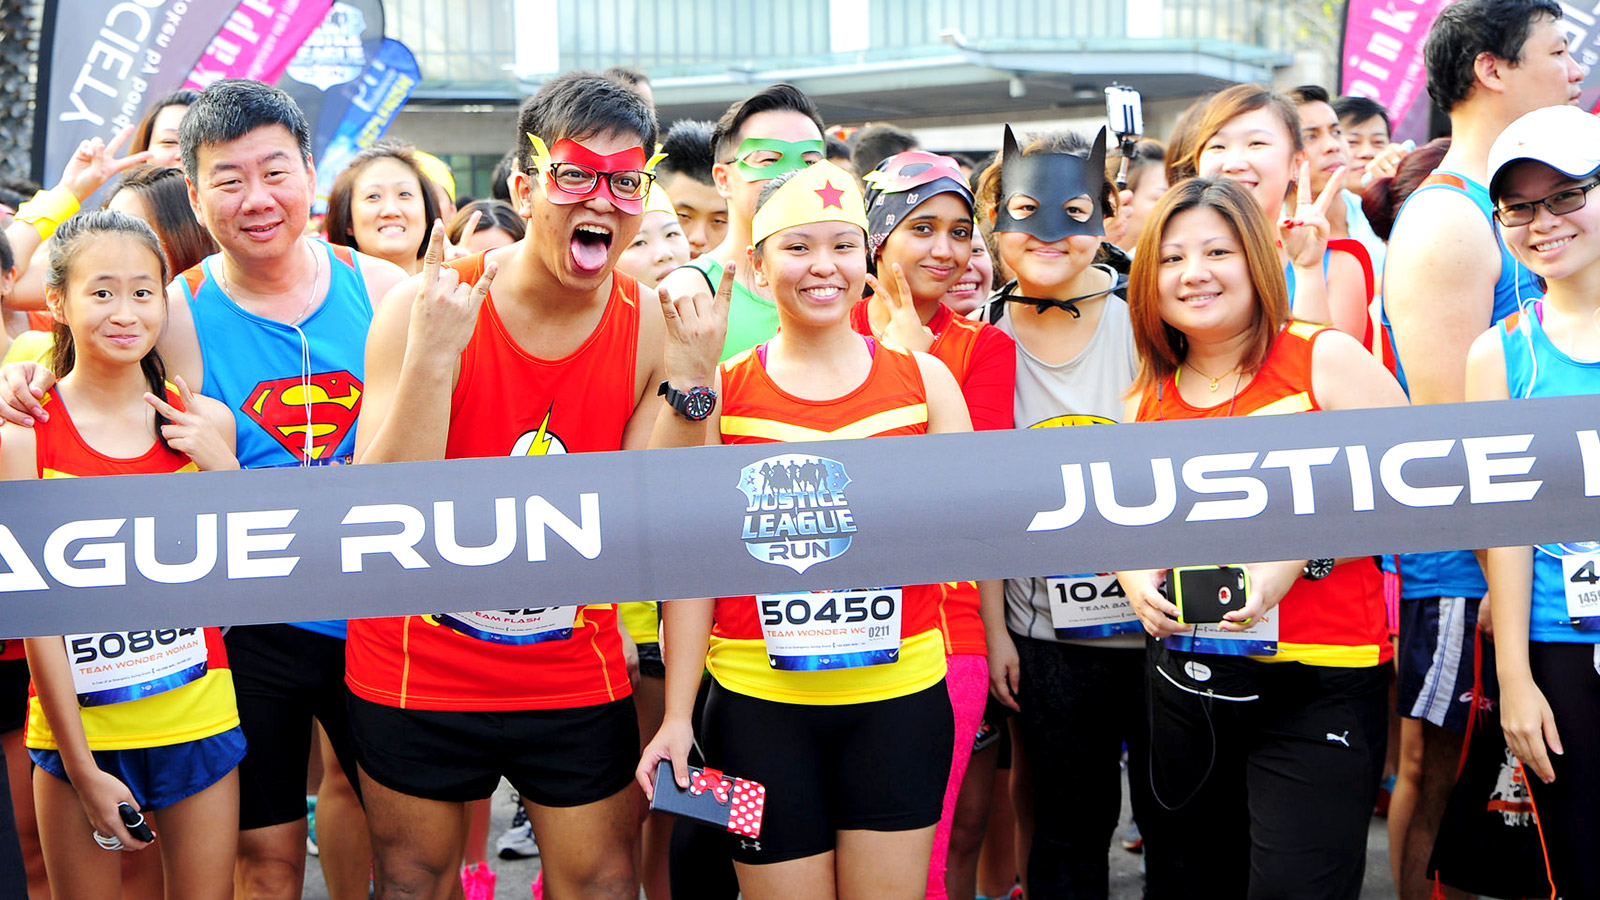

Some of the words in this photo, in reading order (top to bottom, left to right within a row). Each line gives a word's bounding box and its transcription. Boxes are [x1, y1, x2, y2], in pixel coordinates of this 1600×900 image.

[1347, 0, 1427, 98] pink
[1026, 434, 1544, 532] JUSTICE
[746, 488, 848, 512] JUSTICE
[340, 493, 602, 573] RUN
[741, 509, 858, 540] LEAGUE
[769, 541, 831, 561] RUN
[475, 611, 501, 622] EAM
[761, 595, 895, 625] 50450
[1080, 604, 1110, 612] TEAM
[798, 628, 848, 636] WONDER
[868, 625, 890, 638] 0211
[79, 664, 112, 675] TEAM
[116, 652, 164, 669] WONDER
[165, 640, 199, 657] WOMAN
